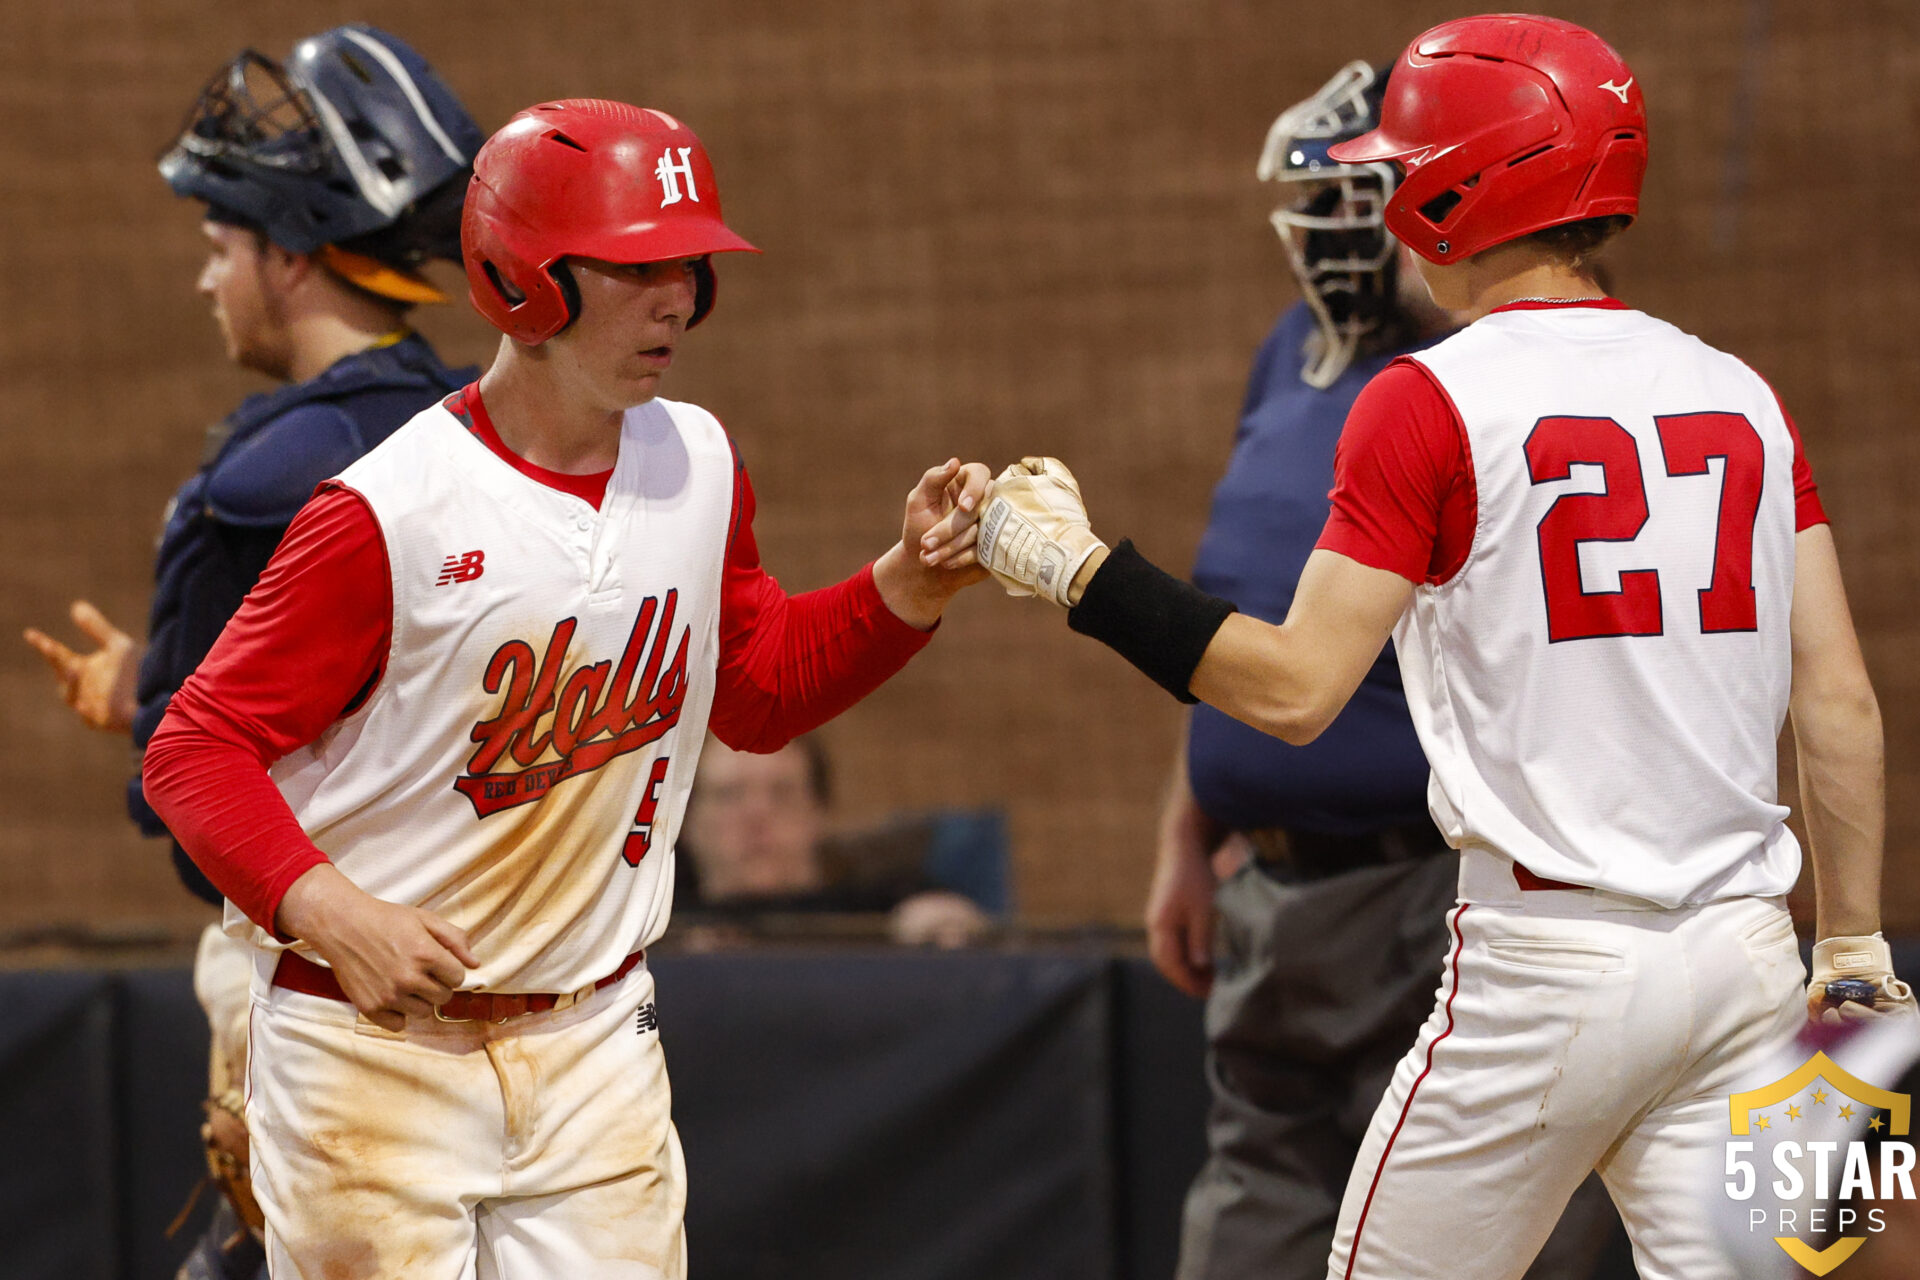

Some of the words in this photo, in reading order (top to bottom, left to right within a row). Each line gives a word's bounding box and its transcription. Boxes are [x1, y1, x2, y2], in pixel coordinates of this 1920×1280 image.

[654, 146, 699, 209] H
[1522, 410, 1765, 644] 27
[435, 549, 485, 587] NB
[466, 587, 691, 777] Halls
[484, 779, 517, 800] RED
